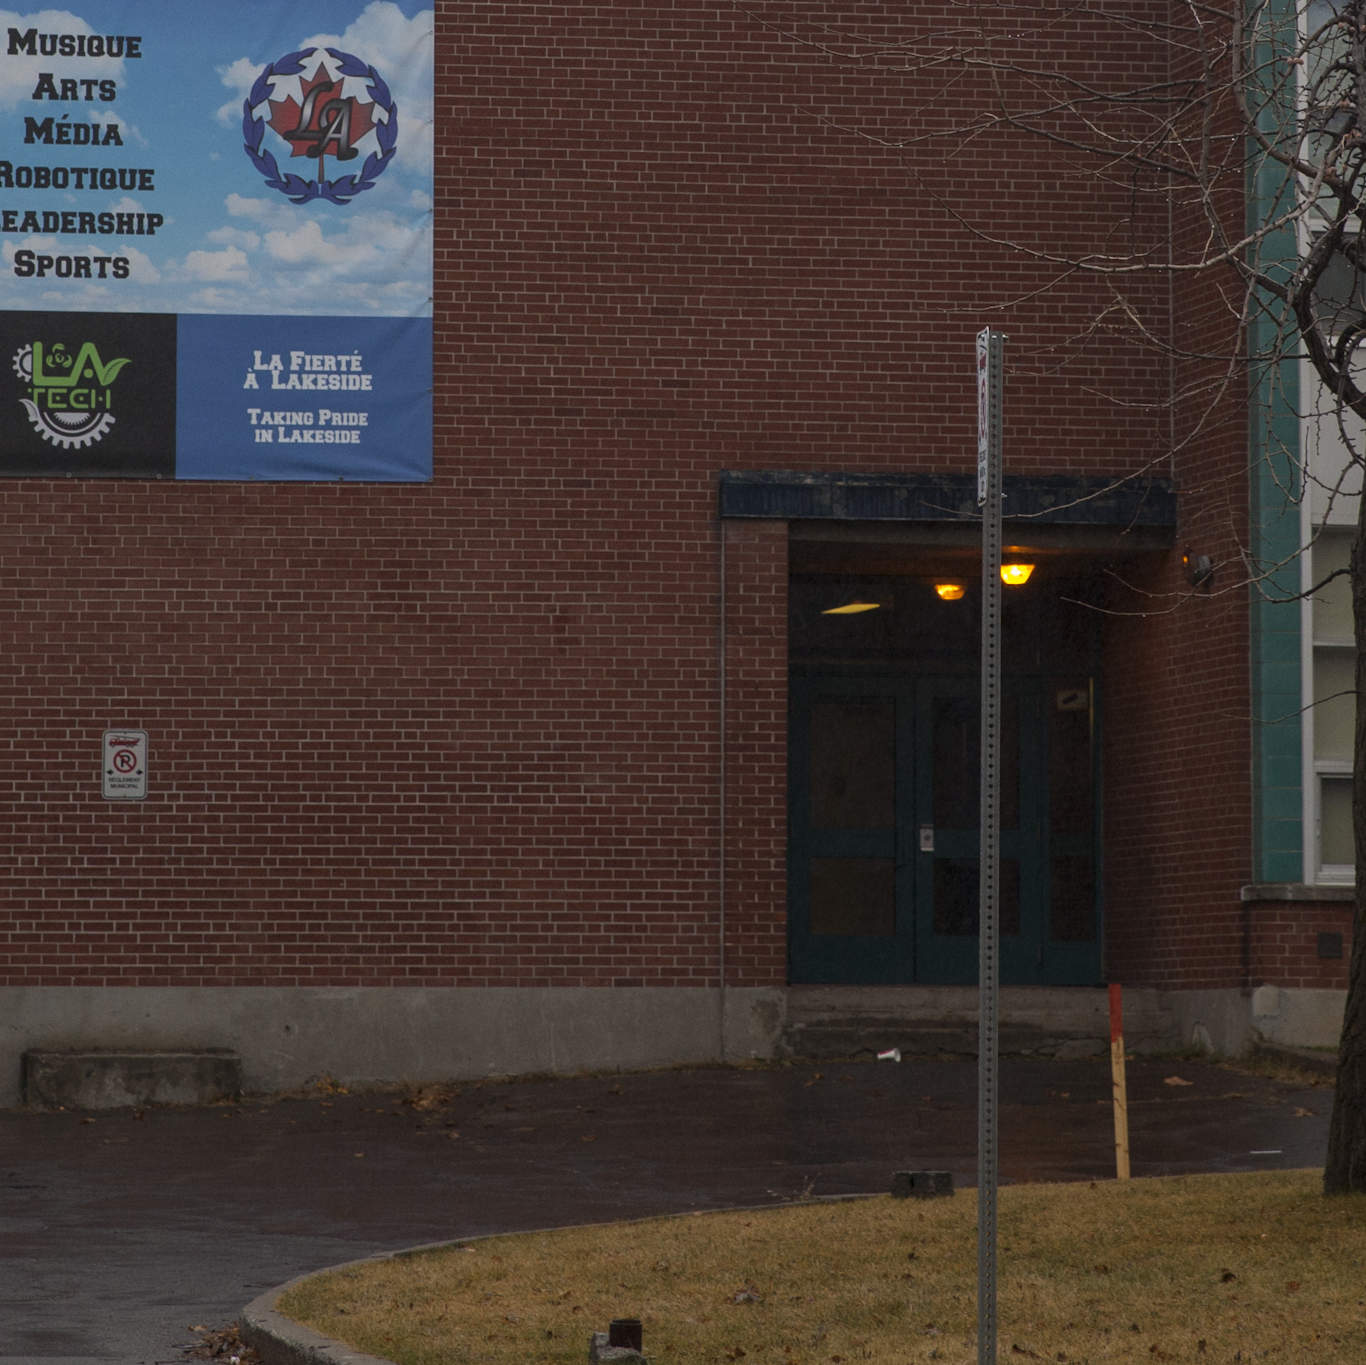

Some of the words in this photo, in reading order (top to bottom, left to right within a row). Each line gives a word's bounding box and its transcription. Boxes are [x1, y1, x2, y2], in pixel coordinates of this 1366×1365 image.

[6, 27, 142, 59] MUSIQUE
[31, 72, 117, 102] ARTS
[23, 114, 124, 146] MÉDIA
[14, 249, 130, 279] SPORTS
[253, 350, 284, 371] LA
[290, 350, 362, 372] FIERTÉ
[243, 368, 259, 389] À
[271, 369, 373, 391] LAKESIDE
[27, 388, 111, 409] TECH
[247, 408, 314, 426] TAKING
[318, 409, 369, 427] PRIDE
[254, 429, 273, 443] IN
[277, 426, 361, 444] LAKESIDE
